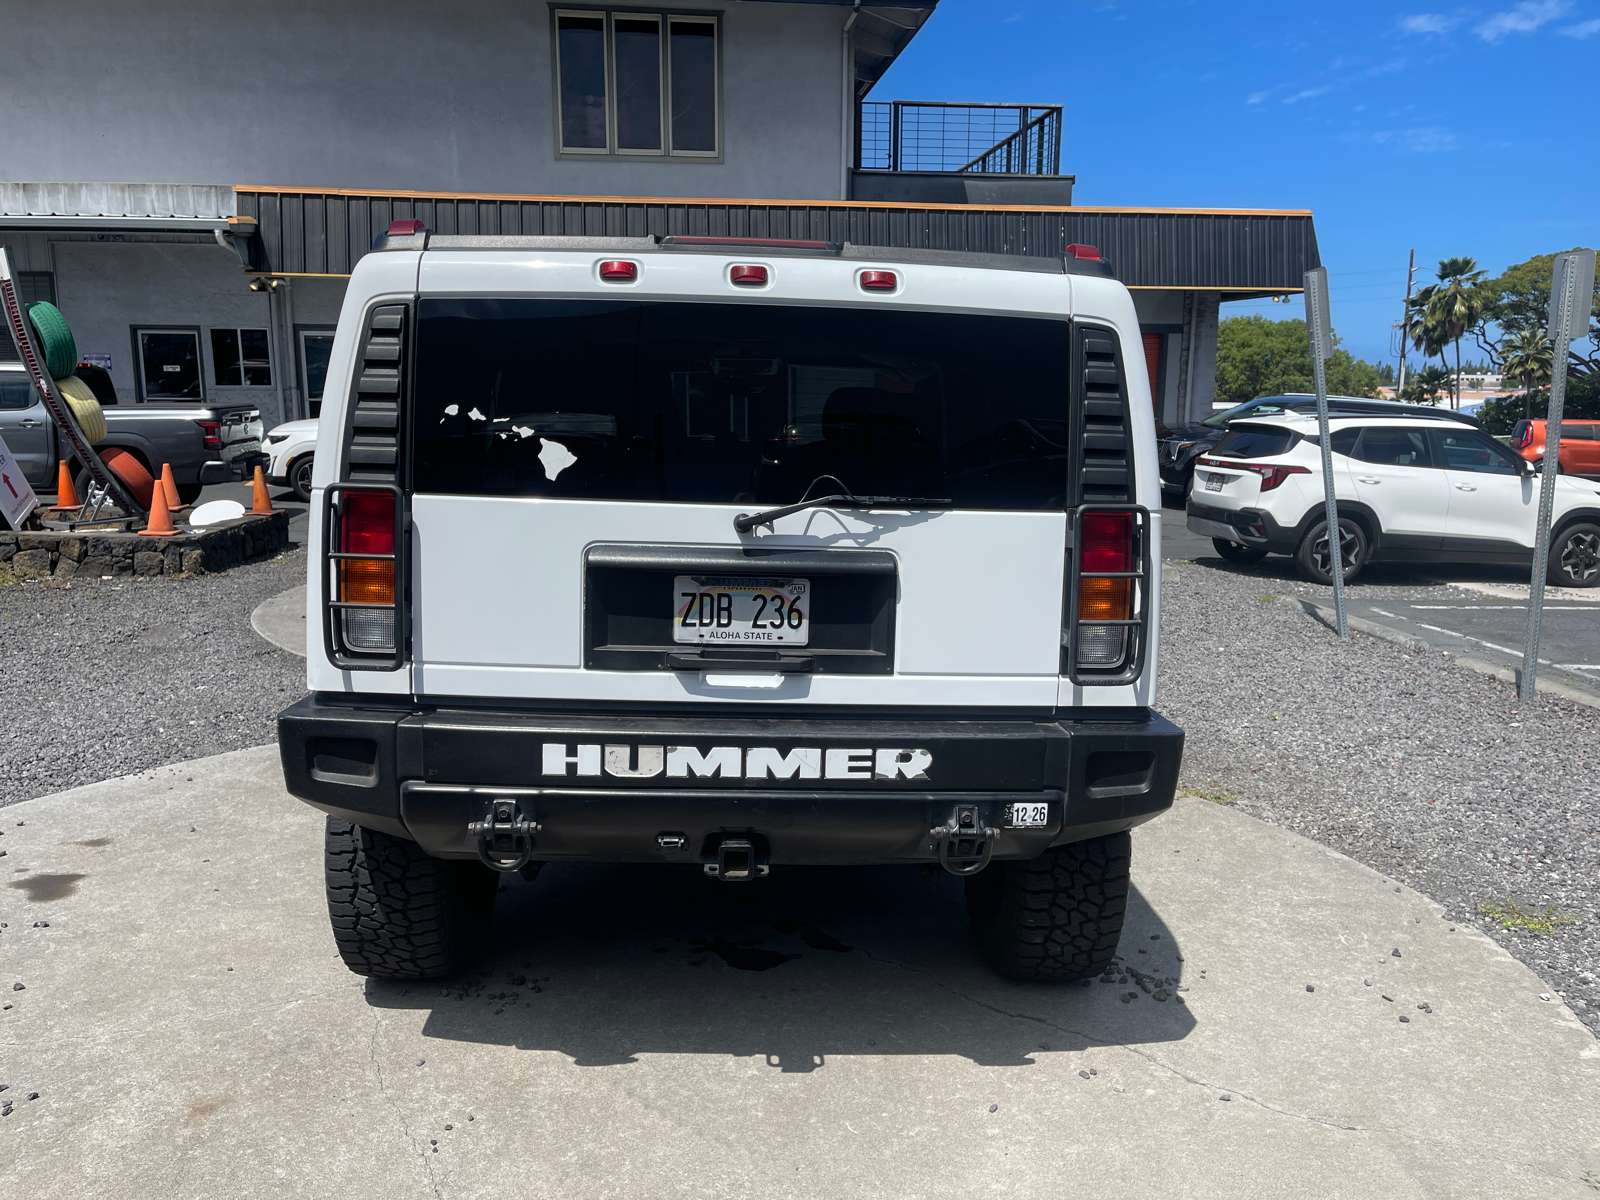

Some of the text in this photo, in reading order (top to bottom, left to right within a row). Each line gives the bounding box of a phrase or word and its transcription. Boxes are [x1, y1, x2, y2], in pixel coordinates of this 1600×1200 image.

[681, 592, 803, 630] ZDB 236
[709, 631, 773, 640] ALOHA STATE
[541, 743, 933, 780] HUMMER
[1014, 806, 1046, 822] 12 26
